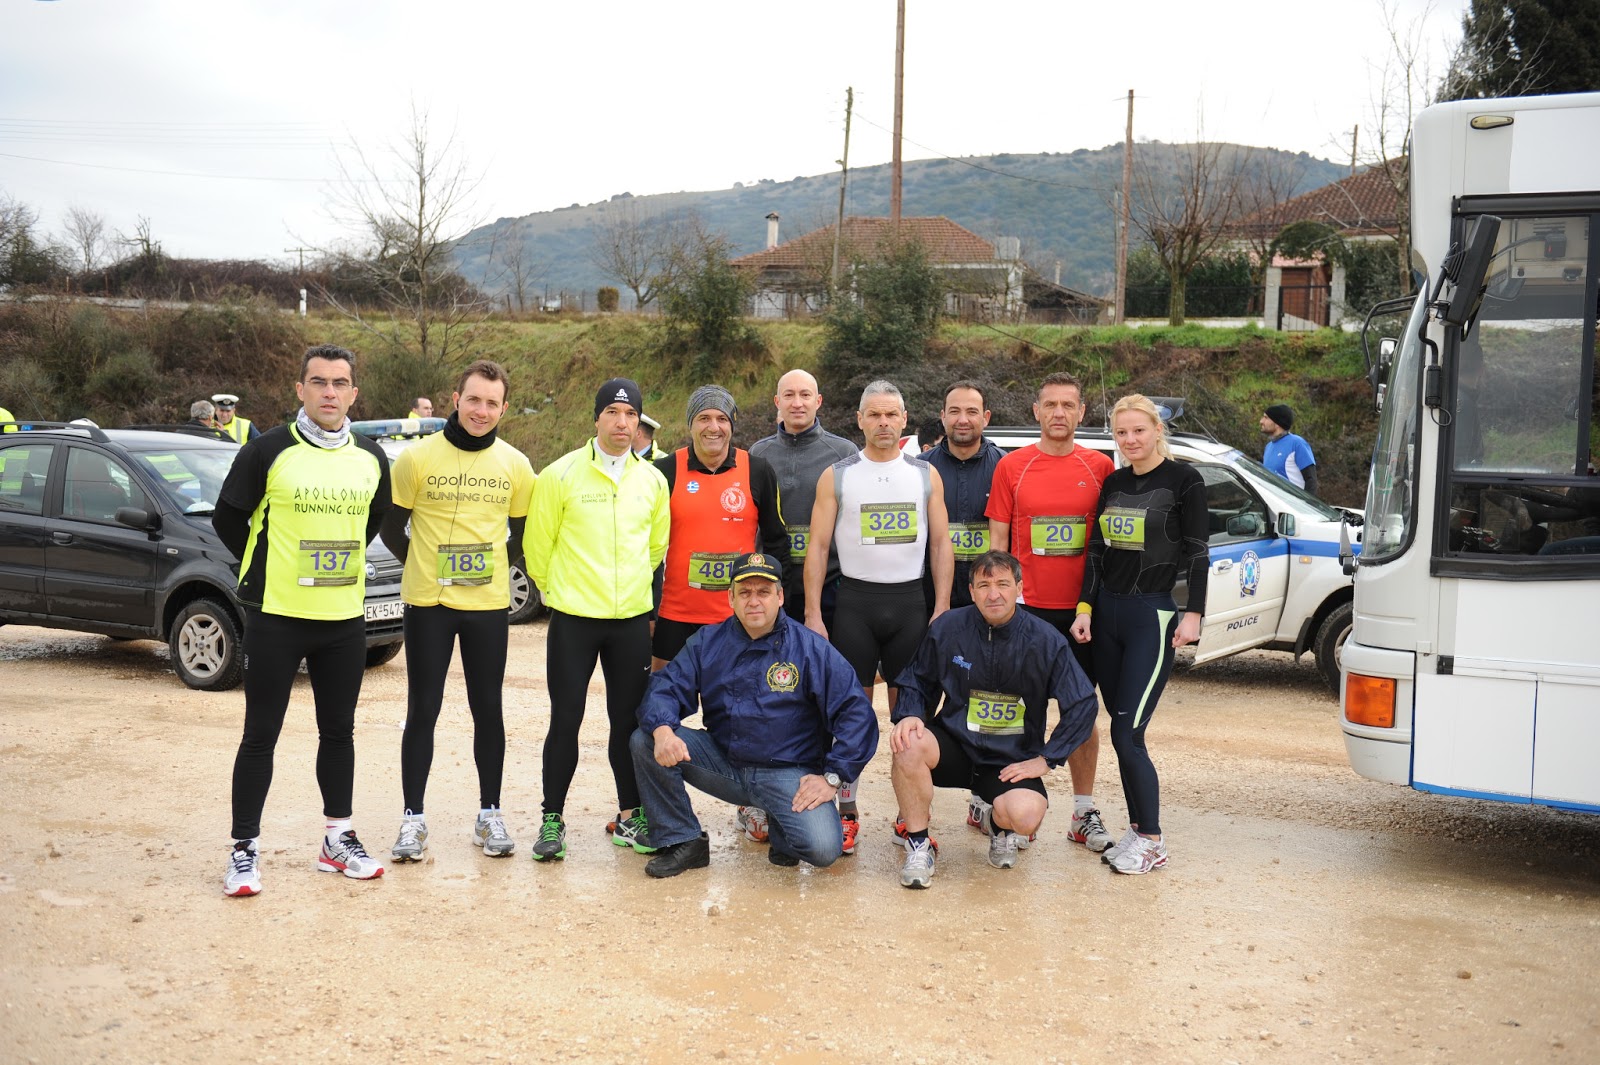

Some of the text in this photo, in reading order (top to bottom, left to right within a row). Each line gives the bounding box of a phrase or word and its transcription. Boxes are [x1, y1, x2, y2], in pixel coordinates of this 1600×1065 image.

[426, 491, 507, 504] RUNNING CLUB
[294, 503, 342, 515] RUNNING
[869, 512, 910, 531] 328
[1105, 516, 1134, 535] 195
[951, 531, 984, 548] 436
[1046, 525, 1073, 542] 20
[310, 551, 351, 571] 137
[448, 553, 486, 572] 183
[698, 561, 733, 579] 481
[1226, 615, 1258, 632] POLICE
[976, 701, 1017, 721] 355
